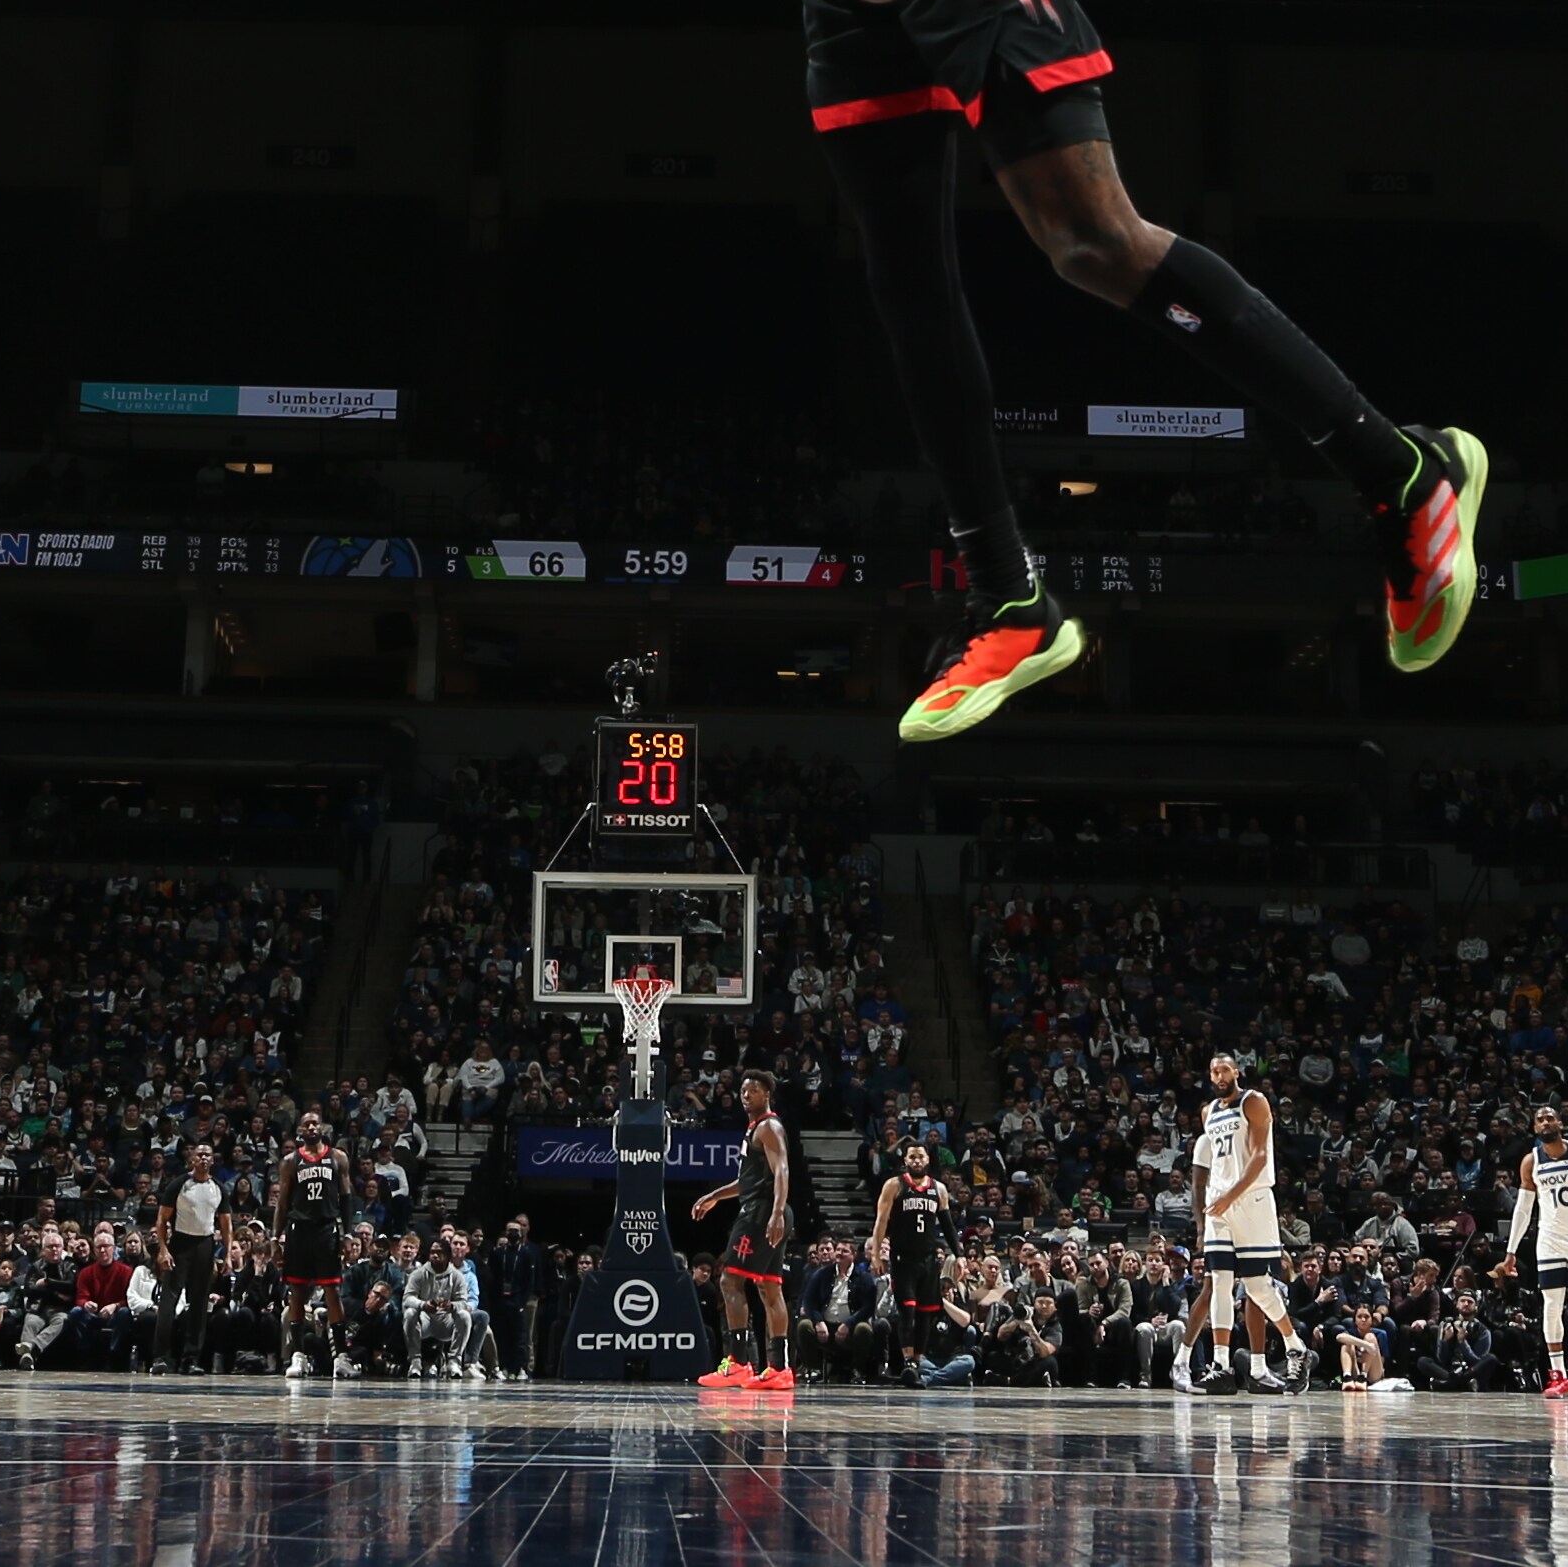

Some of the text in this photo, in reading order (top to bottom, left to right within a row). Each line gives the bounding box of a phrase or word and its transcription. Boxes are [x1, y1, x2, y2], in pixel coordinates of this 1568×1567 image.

[103, 387, 210, 402] slumberland
[268, 390, 375, 406] slumberland
[994, 407, 1058, 422] berland
[1116, 410, 1221, 425] slumberland
[37, 534, 114, 550] SPORTS RADIO
[142, 536, 280, 548] REB 39 FG% 42
[142, 548, 279, 561] AST 12 FT% 73
[445, 546, 459, 555] TO
[476, 547, 495, 556] FLS
[35, 552, 83, 567] FM 100.3
[529, 552, 564, 577] 66
[624, 550, 688, 576] 5:59
[819, 554, 838, 563] FLS
[852, 555, 865, 563] TO
[1102, 556, 1129, 567] FG%
[142, 560, 164, 570] STL
[216, 562, 249, 572] 3PT%
[264, 562, 278, 573] 33
[447, 560, 456, 573] 5
[482, 562, 491, 574] 3
[752, 556, 784, 581] 51
[1103, 569, 1129, 579] FT%
[821, 569, 832, 582] 4
[854, 569, 864, 583] 3
[1495, 574, 1506, 590] 4
[628, 732, 685, 759] 5:58
[617, 759, 677, 805] 20
[627, 814, 690, 827] TISSOT
[1208, 1121, 1239, 1136] WOLVES
[531, 1141, 619, 1165] Michelo
[1216, 1134, 1234, 1158] 27
[297, 1166, 332, 1183] HOUSTON
[307, 1182, 323, 1200] 32
[902, 1197, 939, 1214] HOUSTON
[623, 1210, 657, 1220] MAYO
[620, 1220, 660, 1230] CLINIC
[917, 1214, 925, 1232] 5
[576, 1333, 696, 1350] CFMOTO
